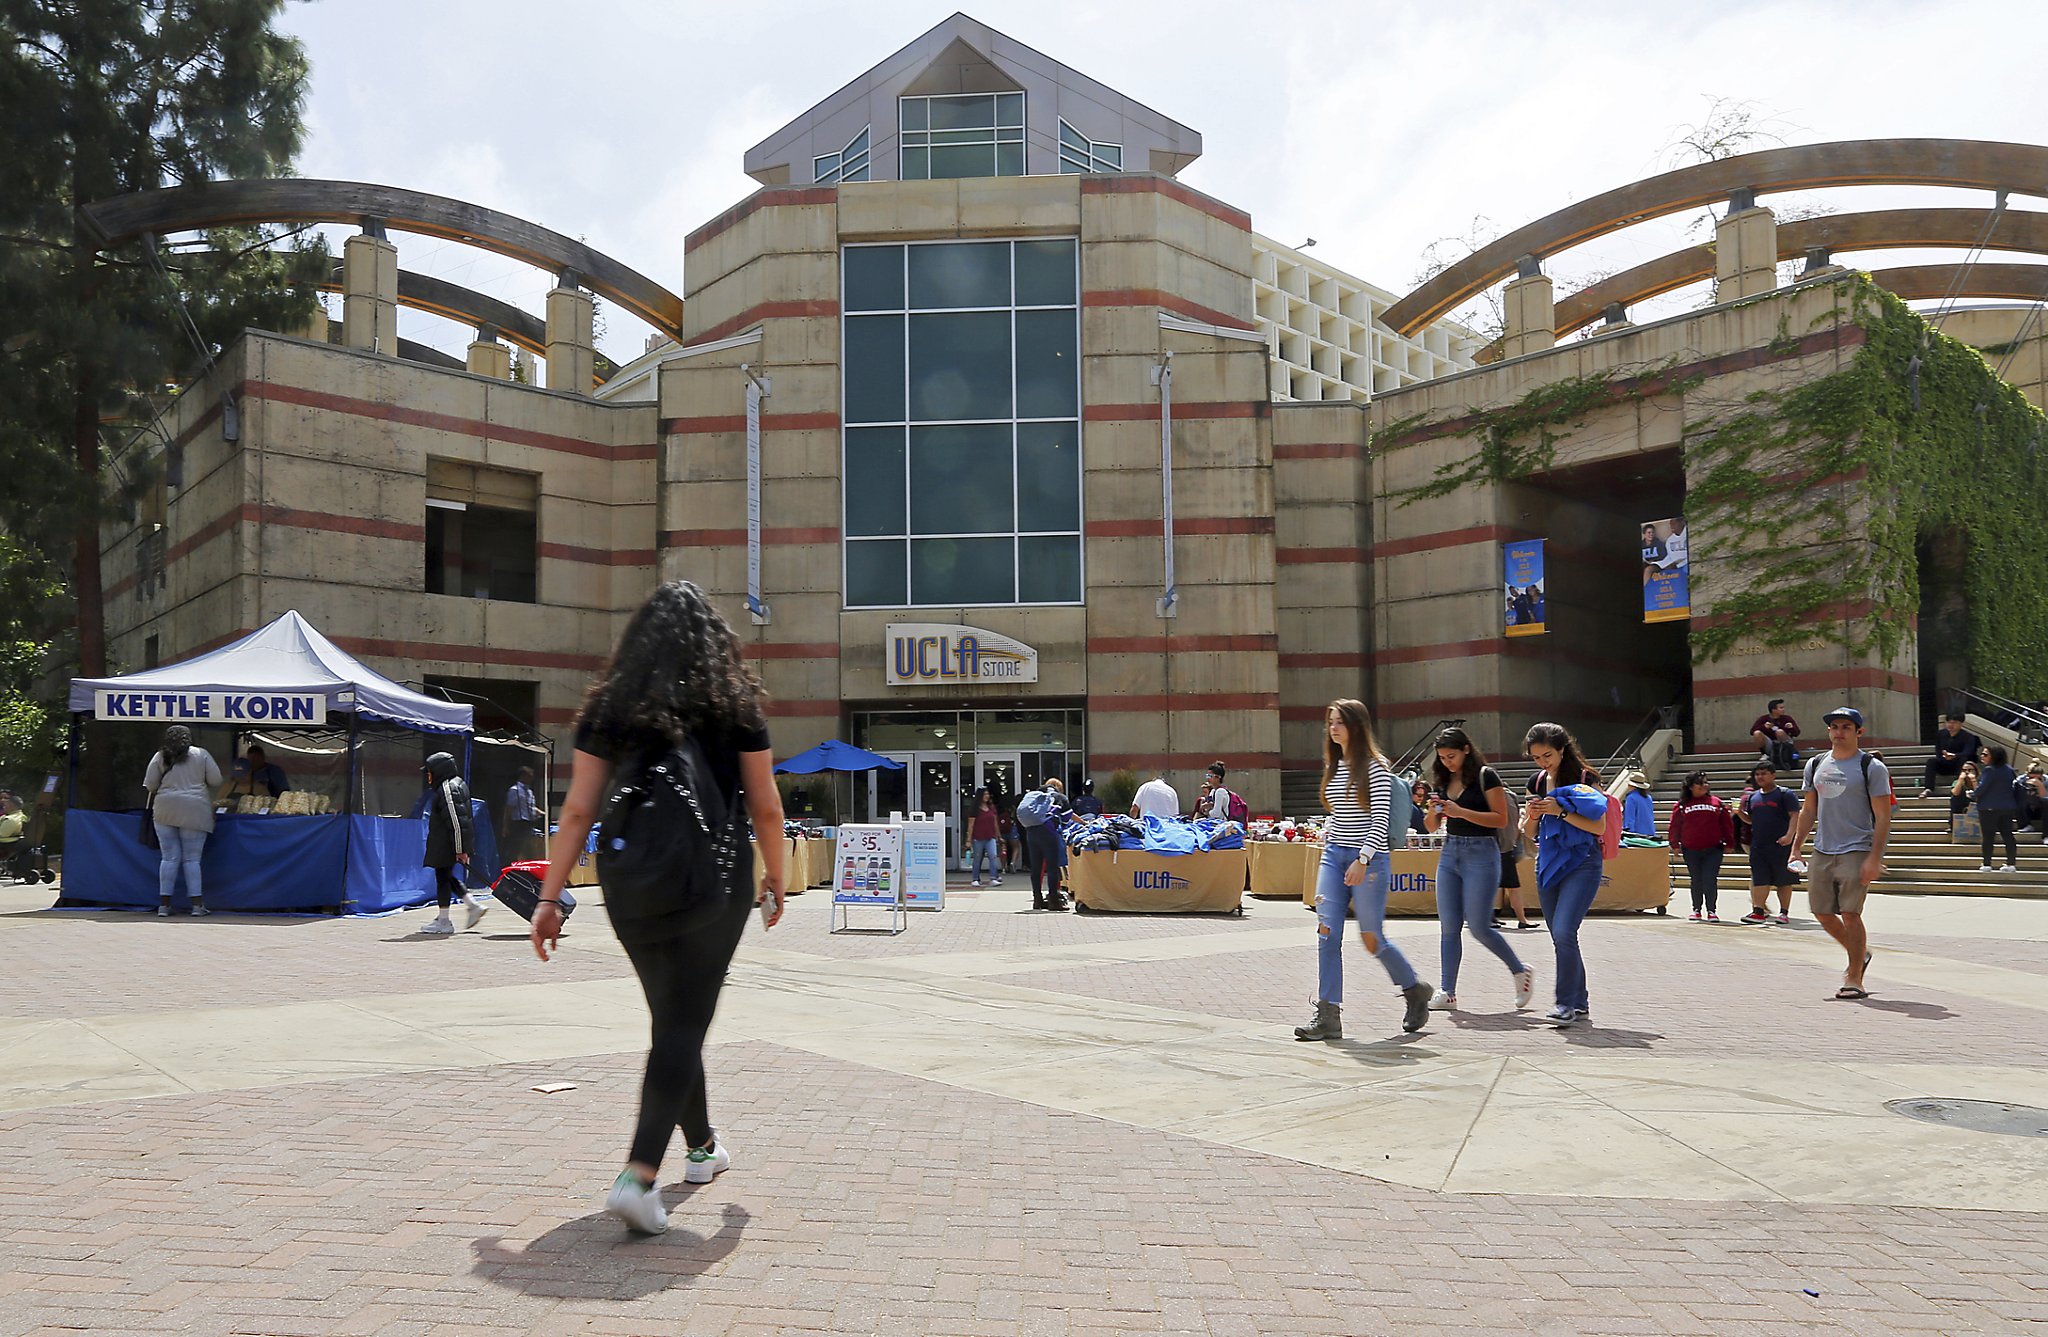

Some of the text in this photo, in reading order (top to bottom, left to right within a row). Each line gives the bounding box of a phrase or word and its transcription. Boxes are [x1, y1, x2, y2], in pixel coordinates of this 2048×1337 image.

[894, 636, 1021, 679] UCLA STORE
[107, 693, 314, 720] KETTLE KORN
[861, 836, 877, 851] $5
[1134, 870, 1170, 889] UCLA
[1389, 873, 1427, 892] UCLA
